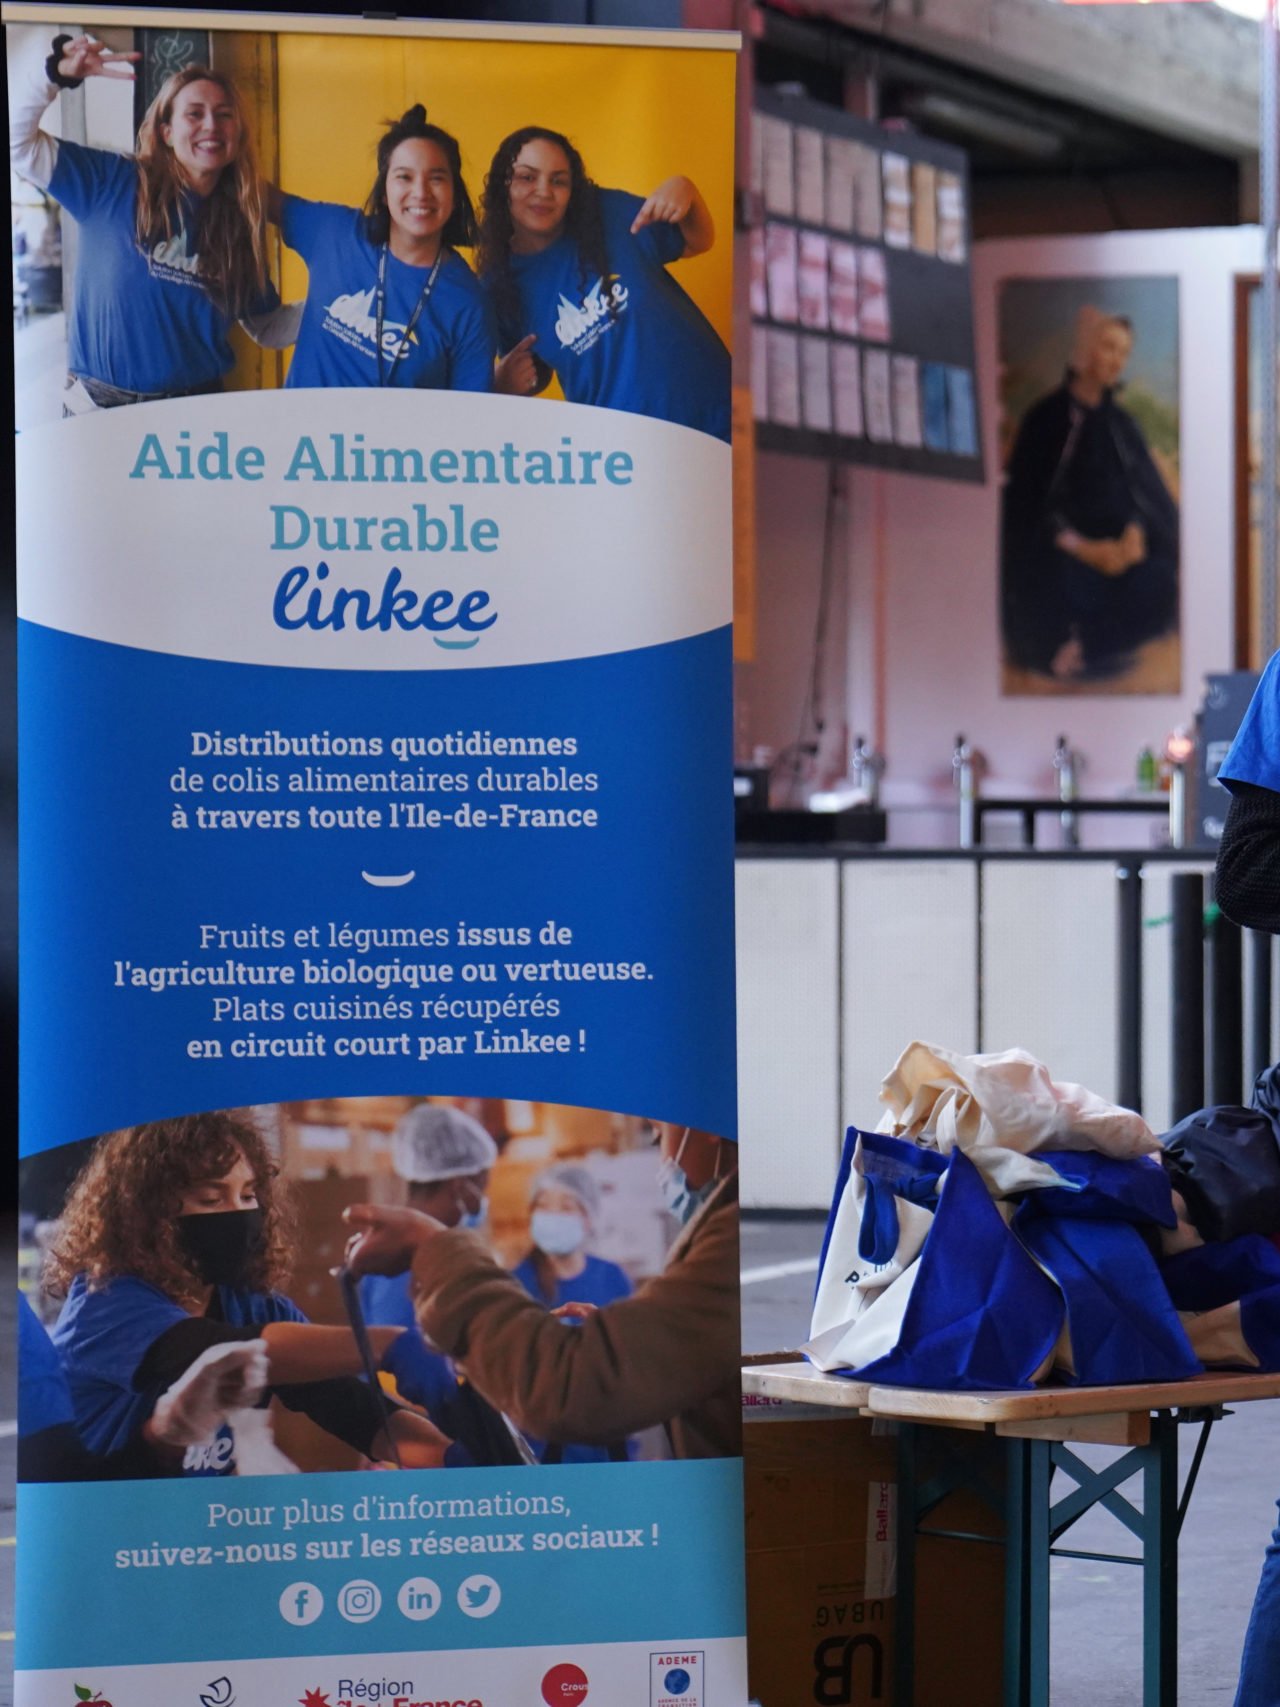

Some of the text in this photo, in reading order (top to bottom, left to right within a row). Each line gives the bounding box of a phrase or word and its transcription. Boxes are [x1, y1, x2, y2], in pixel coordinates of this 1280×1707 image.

[129, 431, 634, 485] Aide Alimentaire
[270, 504, 500, 553] Durable
[273, 561, 498, 632] linkee
[191, 730, 578, 762] Distributions quotidiennes
[170, 766, 598, 792] de colis alimentaires durables
[172, 802, 598, 829] à travers toute l'Ile-de-France
[200, 920, 572, 953] Fruits et légumes issus de
[114, 958, 653, 992] l'agriculture biologique ou vertueuse.
[213, 992, 560, 1025] Plats cuisinés récupérés
[188, 1028, 585, 1061] en circuit court par Linkee !
[208, 1491, 571, 1530] Pour plus d'informations,
[115, 1523, 658, 1568] suivez-nous sur les réseaux sociaux !
[658, 1655, 697, 1665] ADEME
[338, 1677, 414, 1702] Région
